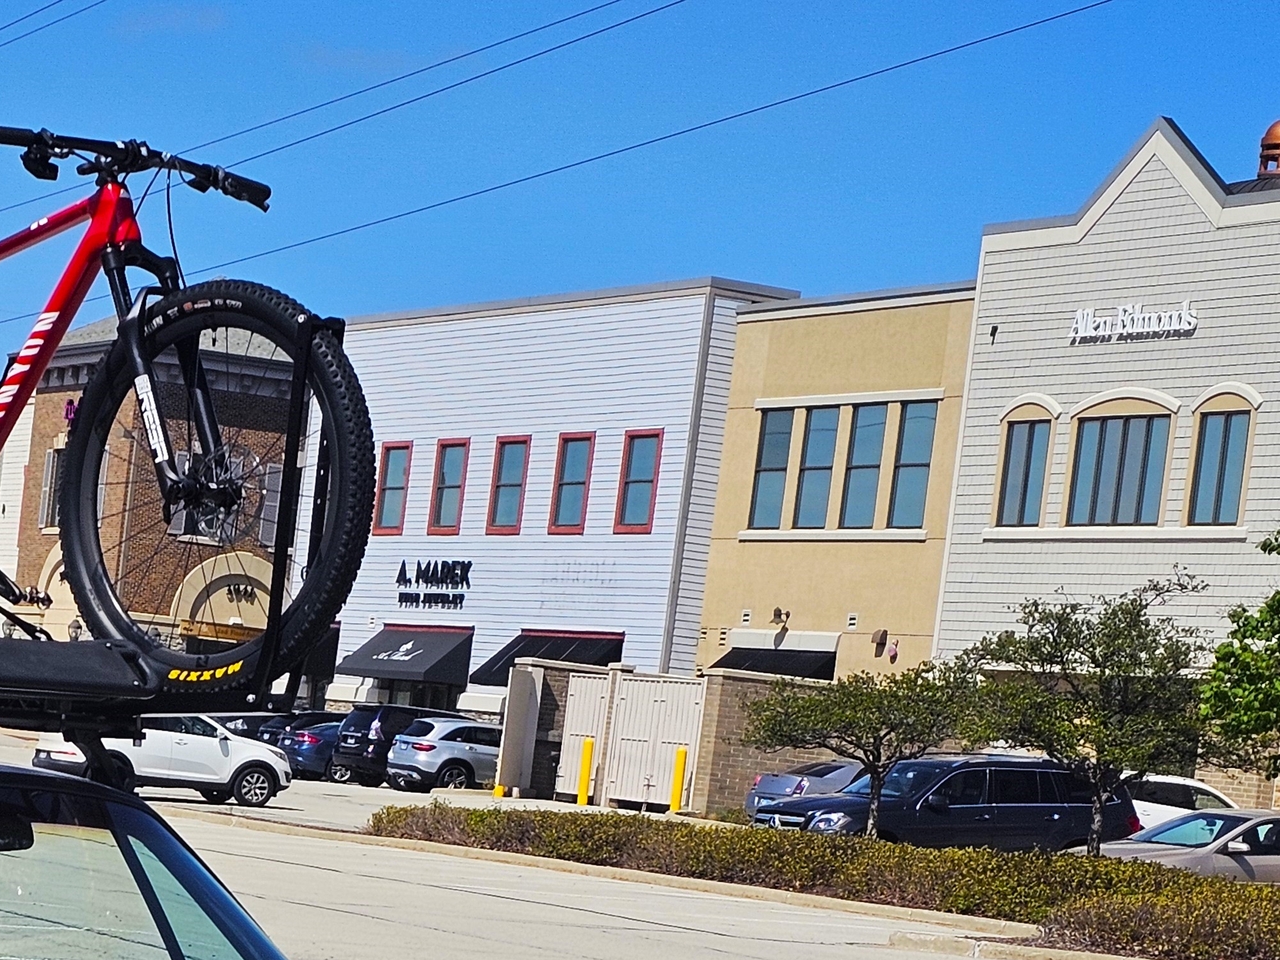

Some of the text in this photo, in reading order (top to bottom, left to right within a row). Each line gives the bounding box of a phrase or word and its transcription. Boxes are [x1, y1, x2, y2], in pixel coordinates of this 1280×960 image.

[1068, 300, 1198, 337] Allen Edmonds
[396, 559, 472, 588] A. MAREK
[167, 660, 243, 681] MAXXIS
